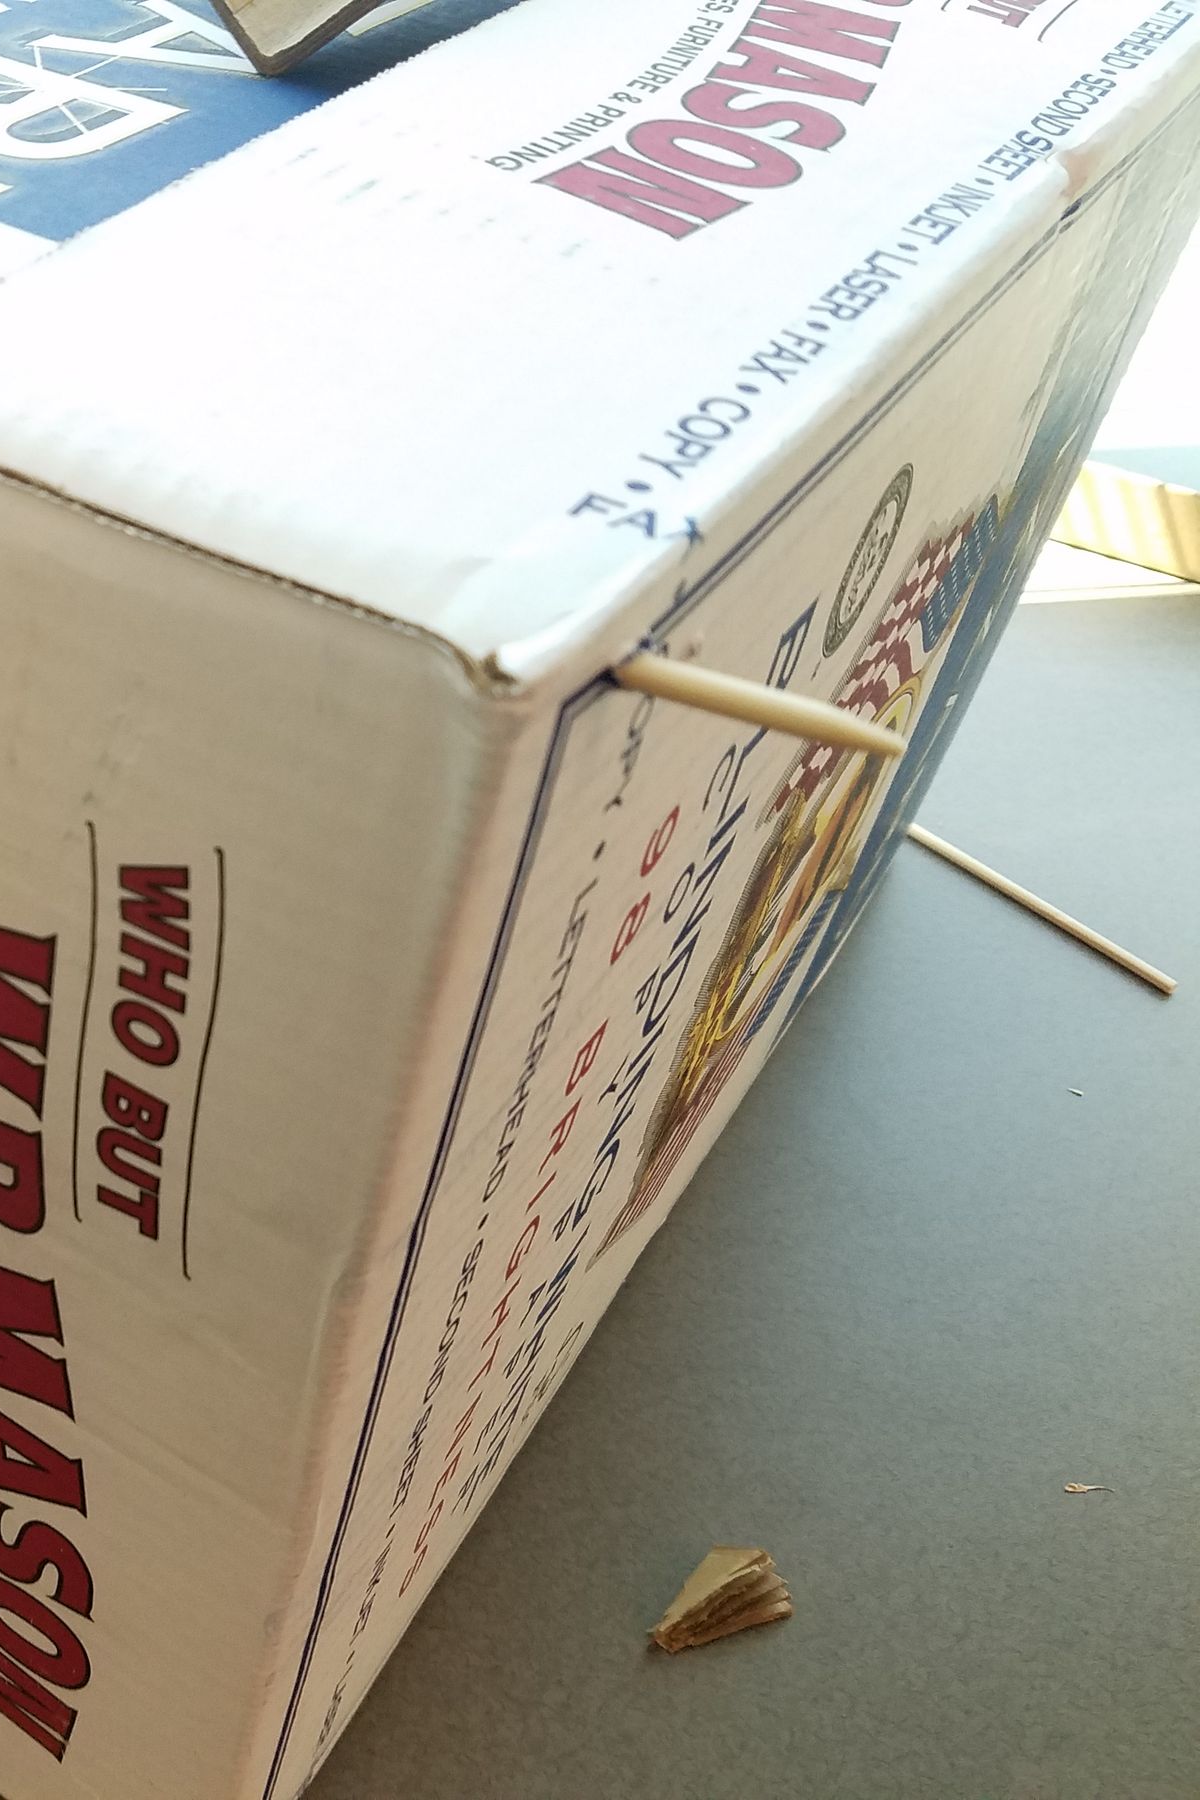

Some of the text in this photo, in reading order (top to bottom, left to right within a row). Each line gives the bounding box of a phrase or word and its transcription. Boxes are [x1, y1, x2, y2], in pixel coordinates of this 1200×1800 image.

[484, 14, 725, 171] FURNITURE & PRINTING
[531, 0, 902, 240] MASON
[977, 130, 1054, 181] SHEET
[1030, 73, 1117, 137] SECOND
[809, 249, 918, 321] LASER
[901, 183, 995, 245] INKJET
[739, 329, 827, 384] FAX
[639, 397, 751, 480] COPY
[571, 592, 819, 1232] BLINDING
[597, 743, 737, 1105] COPY
[96, 864, 189, 1241] WHO BUT
[483, 876, 600, 1202] LETTERHEAD
[399, 804, 681, 1599] 98 BRIGHTNESS
[423, 1238, 485, 1405] SECOND
[389, 1404, 433, 1519] SHEET
